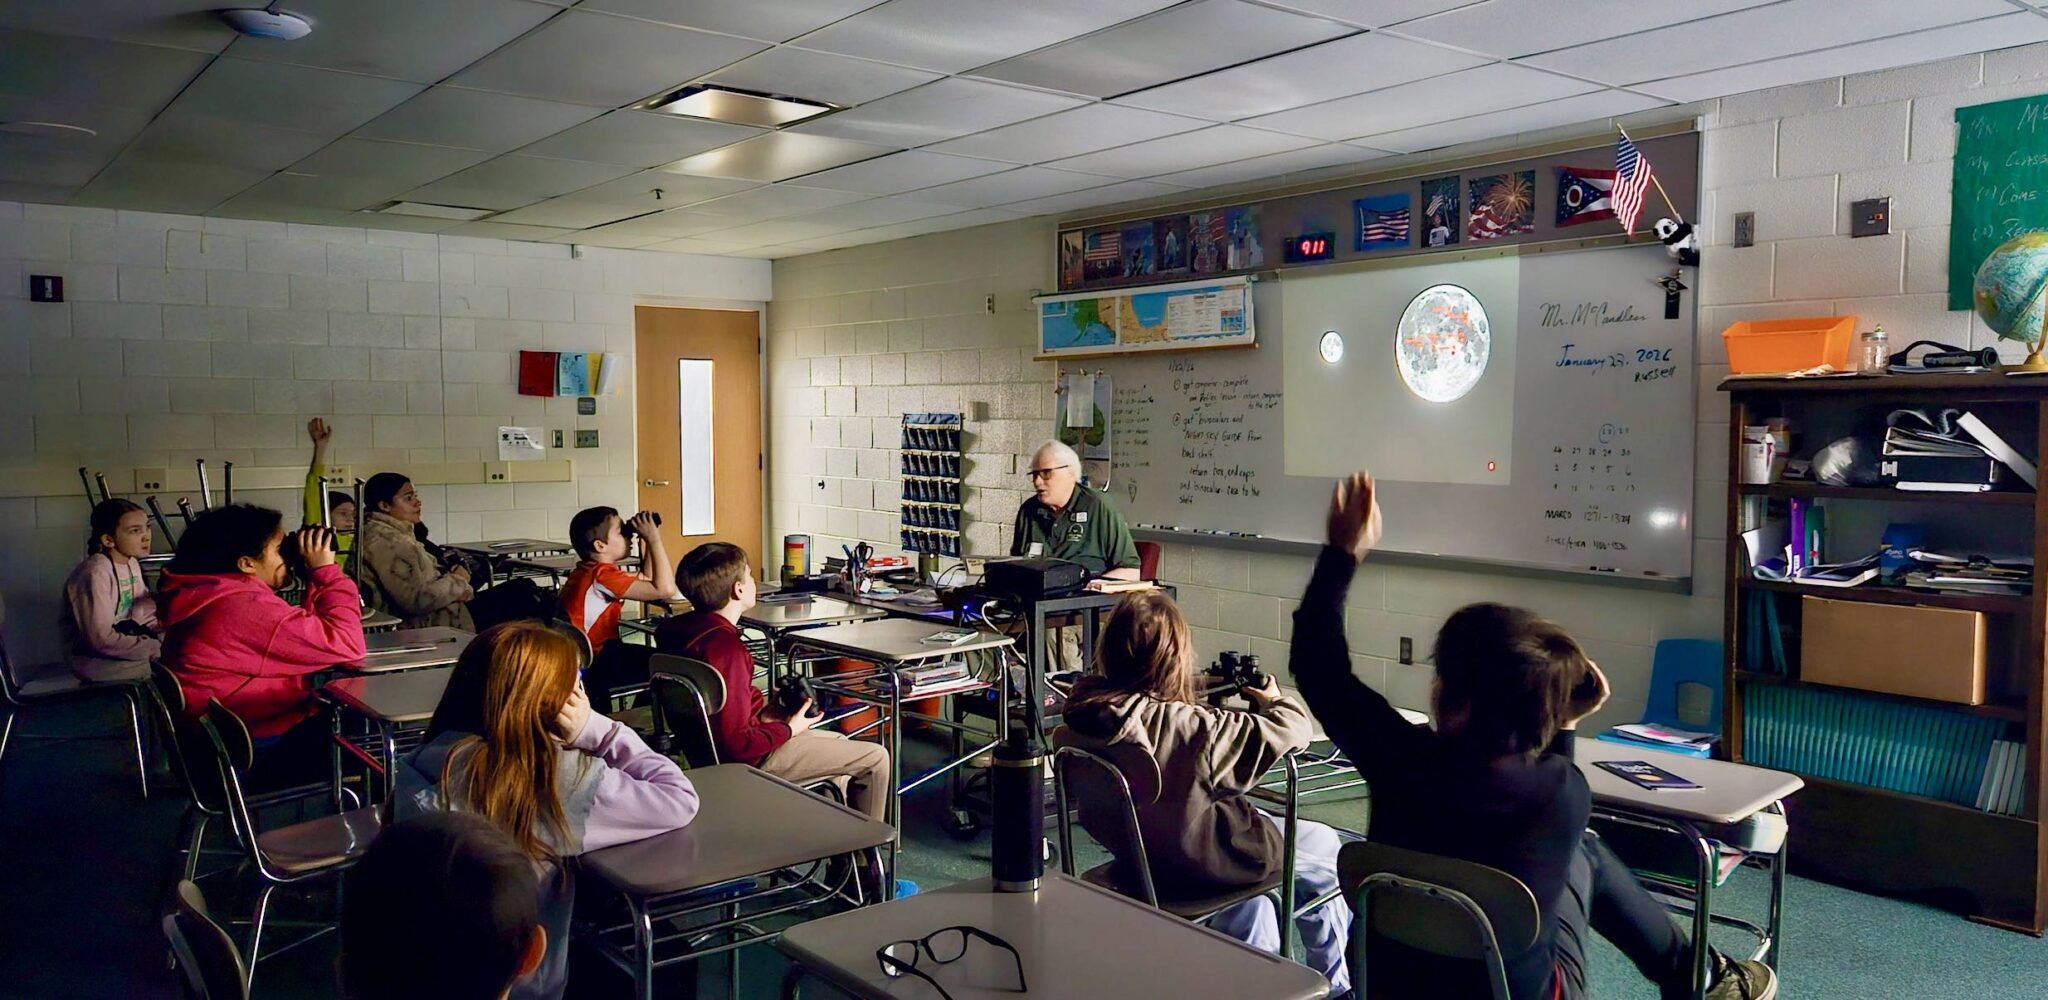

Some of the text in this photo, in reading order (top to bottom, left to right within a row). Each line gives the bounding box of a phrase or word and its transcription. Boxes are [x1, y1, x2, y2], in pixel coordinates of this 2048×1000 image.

[1539, 302, 1568, 328] Mr.
[1556, 344, 1605, 373] January
[1636, 348, 1672, 363] 2026
